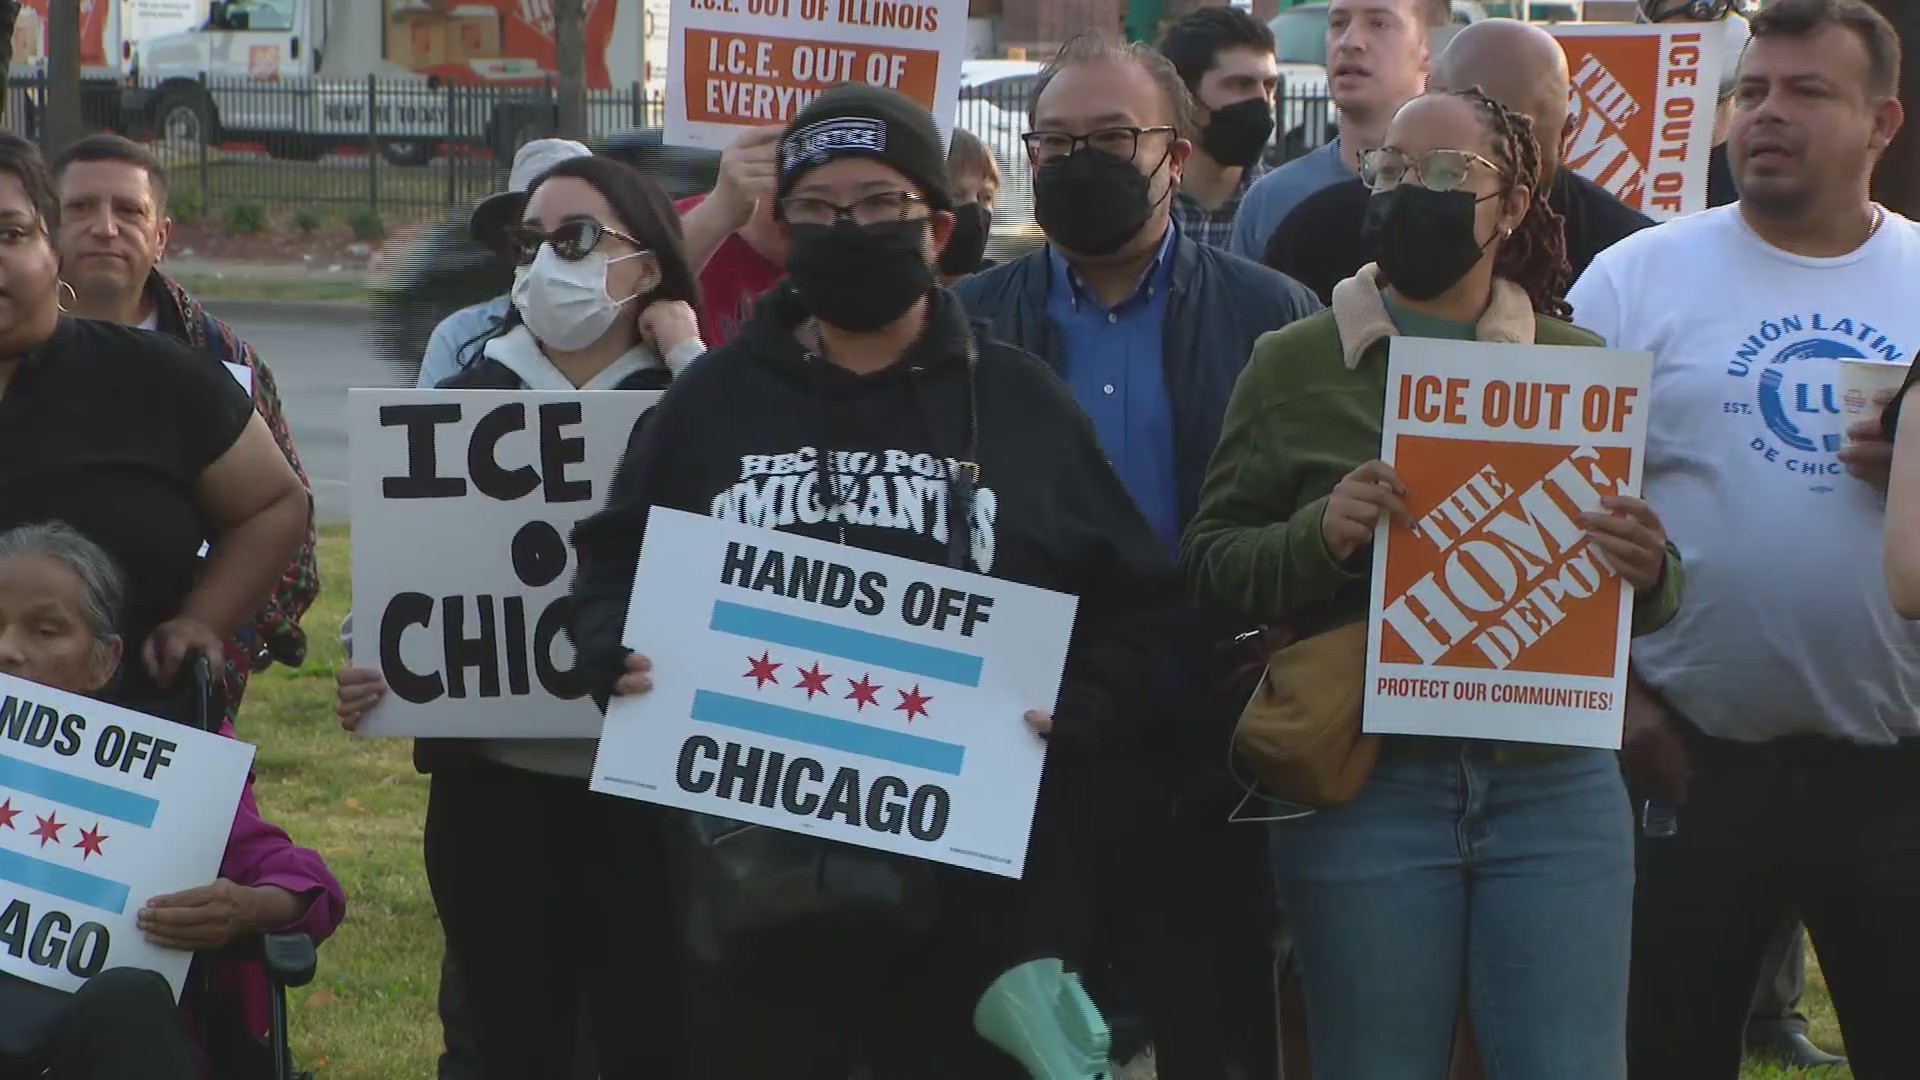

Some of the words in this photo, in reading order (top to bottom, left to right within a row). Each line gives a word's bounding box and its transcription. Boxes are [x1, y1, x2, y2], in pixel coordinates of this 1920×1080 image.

[748, 0, 789, 18] OUT
[800, 0, 829, 22] OF
[838, 0, 939, 32] ILLINOIS
[708, 37, 780, 78] I.C.E.
[791, 45, 856, 83] OUT
[865, 50, 908, 89] OF
[1666, 33, 1701, 87] ICE
[1572, 52, 1641, 130] THE
[799, 129, 880, 156] JUSTICE
[1658, 97, 1696, 161] OUT
[1650, 171, 1684, 212] OF
[1727, 314, 1803, 377] UNIÓN
[1397, 374, 1470, 424] ICE
[1481, 379, 1571, 430] OUT
[1581, 384, 1638, 432] OF
[1723, 402, 1752, 415] EST.
[379, 401, 592, 503] ICE
[1749, 437, 1781, 462] DE
[1413, 464, 1514, 553] THE
[1383, 446, 1629, 665] HOME
[720, 540, 888, 616] HANDS
[901, 581, 994, 637] OFF
[1377, 678, 1449, 699] PROTECT
[1453, 682, 1487, 701] OUR
[1491, 684, 1613, 711] COMMUNITIES!
[94, 725, 178, 780] OFF
[675, 735, 951, 842] CHICAGO
